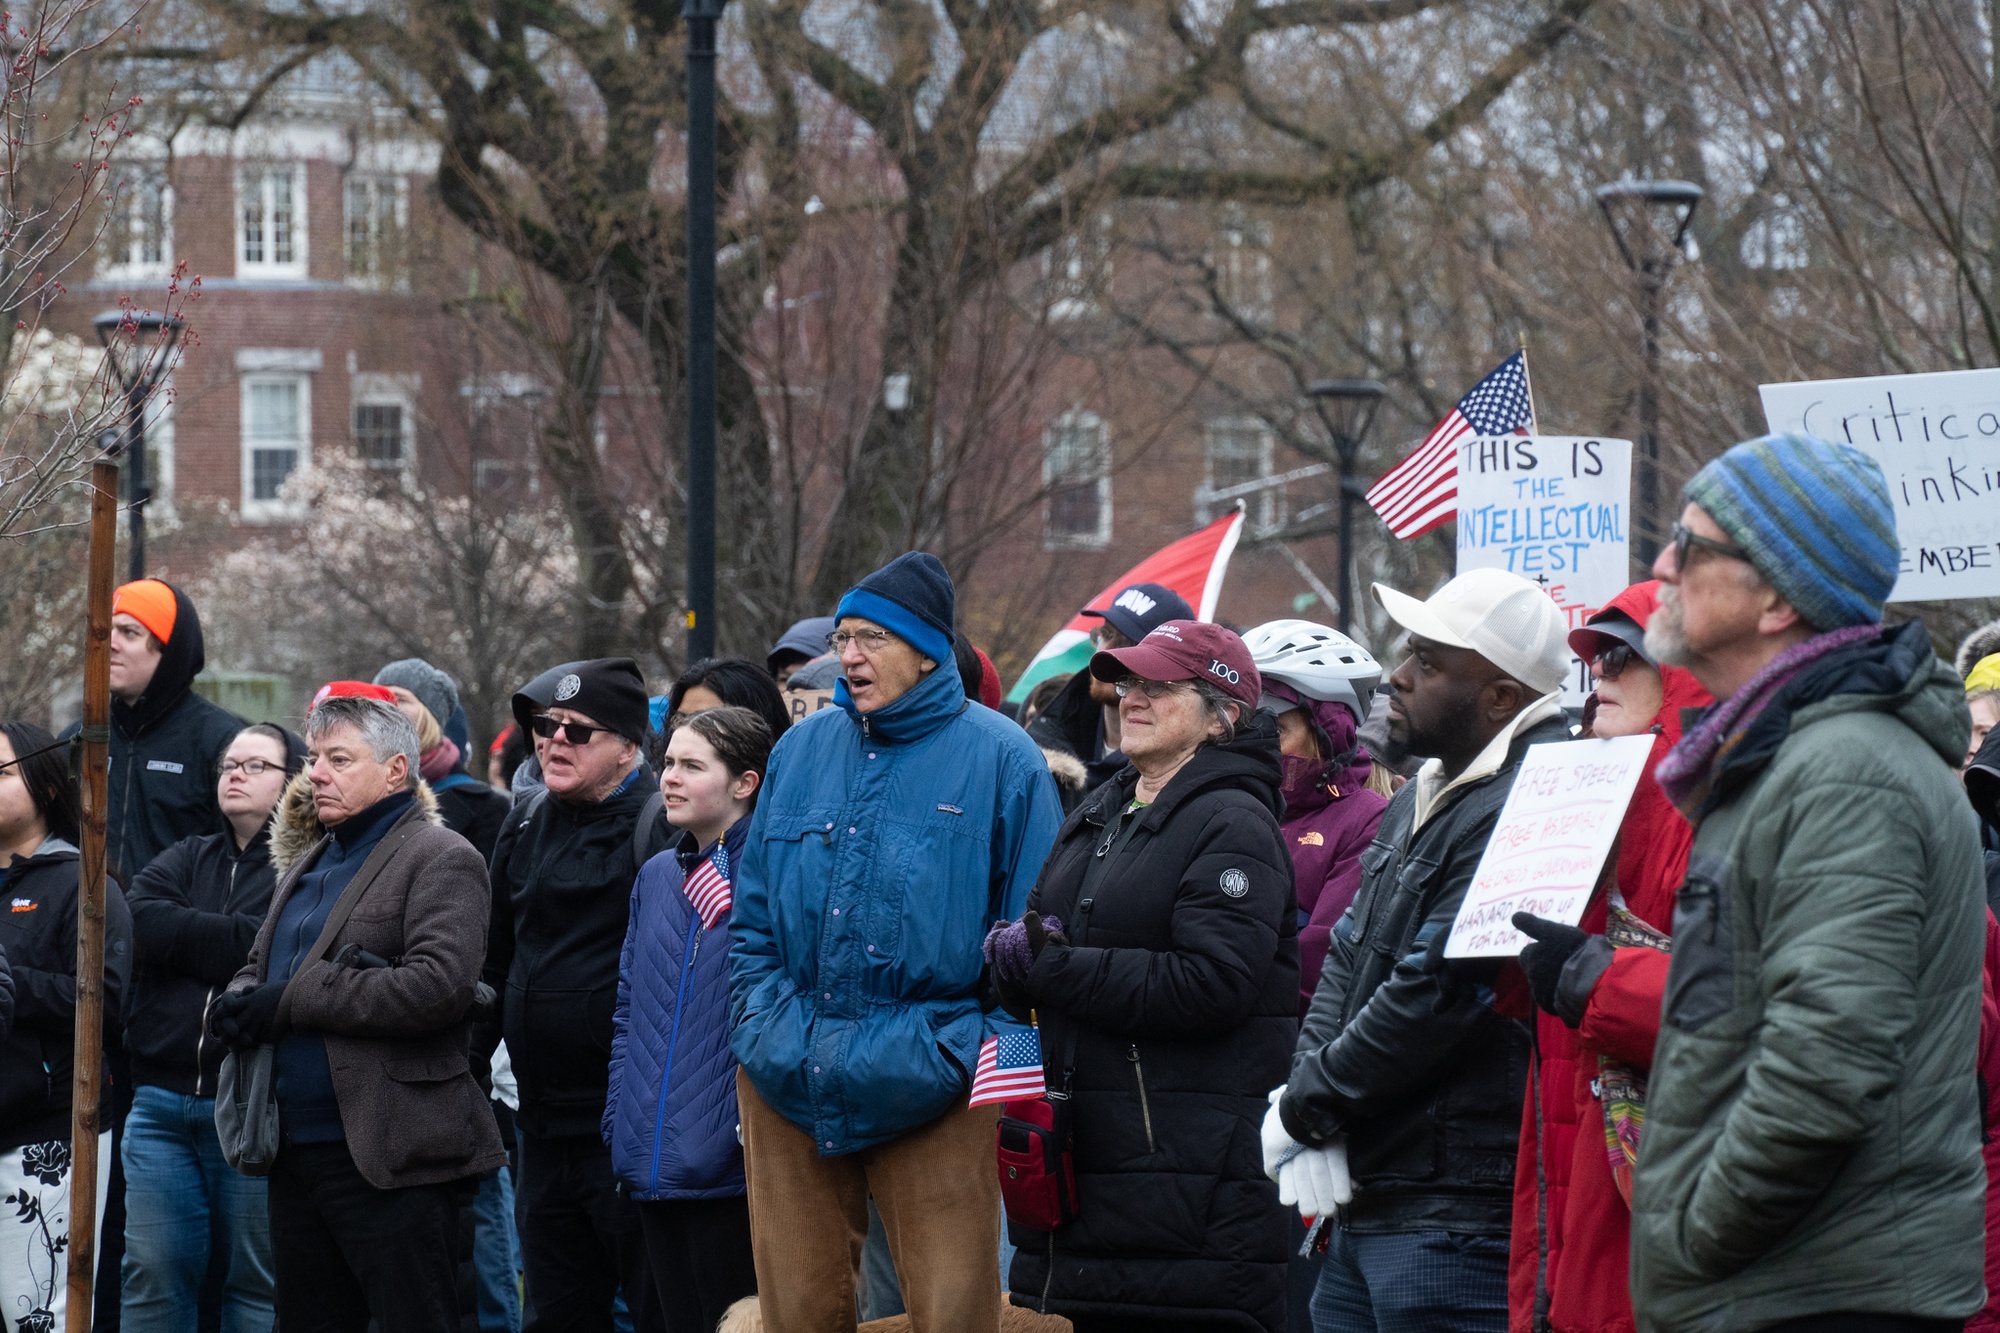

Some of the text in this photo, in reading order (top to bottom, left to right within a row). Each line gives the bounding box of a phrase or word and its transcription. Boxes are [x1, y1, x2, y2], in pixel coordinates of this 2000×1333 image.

[1462, 440, 1603, 478] THIS IS
[1513, 477, 1566, 499] THE
[1901, 457, 2000, 507] inki
[1502, 542, 1590, 573] TEST
[1899, 544, 2000, 576] EMBE
[1208, 660, 1240, 685] 100
[1514, 764, 1629, 806] FREE SPEECH
[1490, 812, 1608, 856] FREE ASSEMBLY
[1455, 901, 1512, 935] HARVARD
[1558, 897, 1576, 916] UP
[1467, 931, 1490, 953] FOR
[1493, 930, 1518, 947] OUR
